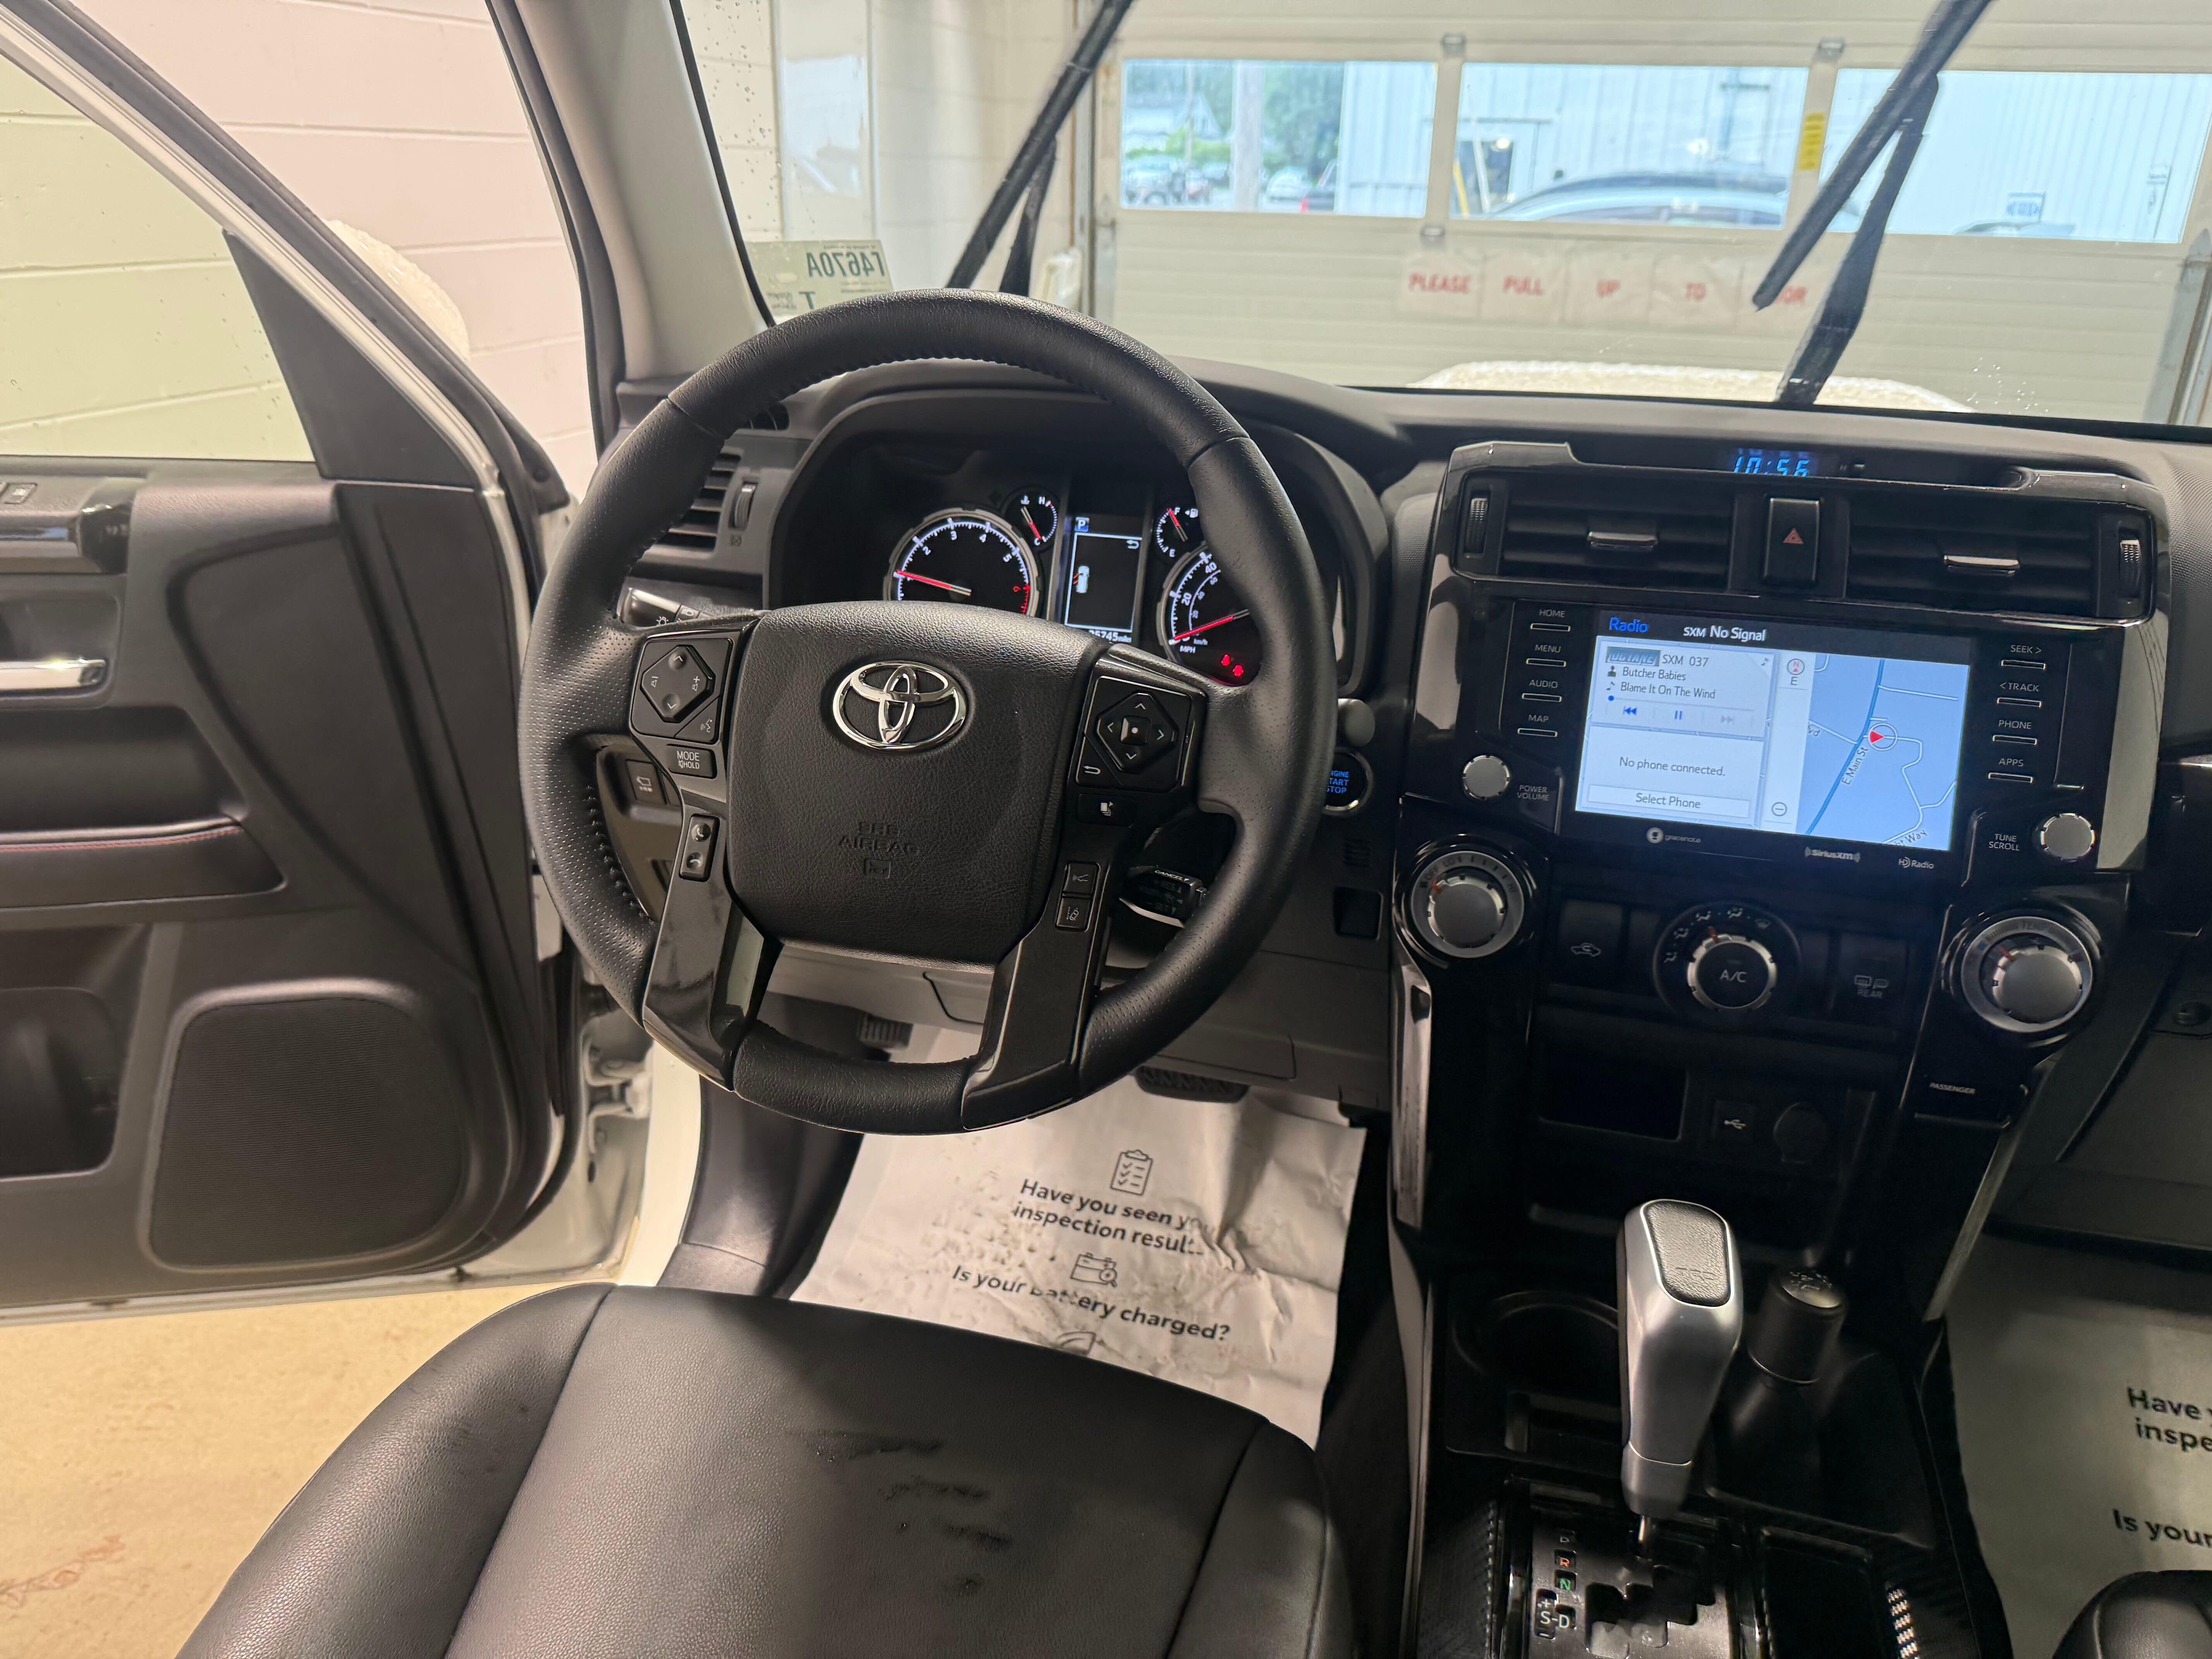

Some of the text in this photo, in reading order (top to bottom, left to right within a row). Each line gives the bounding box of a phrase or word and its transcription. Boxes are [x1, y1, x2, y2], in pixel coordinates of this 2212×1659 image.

[1408, 274, 1469, 294] PLEASE
[1503, 276, 1544, 295] PULL
[1596, 280, 1620, 298] UP
[1685, 283, 1706, 302] TO
[1174, 507, 1180, 515] F
[1078, 519, 1086, 530] P
[950, 531, 957, 541] 3
[979, 534, 987, 543] 4
[922, 546, 931, 555] 2
[1169, 549, 1175, 557] E
[1003, 554, 1012, 562] 5
[1205, 562, 1217, 574] 40
[1181, 592, 1192, 606] 20
[1539, 609, 1565, 618] HOME
[1609, 617, 1649, 634] Radio
[1683, 625, 1767, 642] SXM No Signal
[1180, 645, 1196, 653] MPH
[1535, 644, 1561, 653] MENU
[1662, 654, 1683, 665] SXM
[1689, 656, 1709, 667] 037
[1622, 666, 1686, 681] Butcher Babies
[1529, 679, 1558, 689] AUDIO
[1790, 677, 1797, 686] E
[1621, 682, 1716, 699] Blame It On The Wind
[2008, 682, 2039, 692] TRACK
[1528, 714, 1549, 723] MAP
[1998, 720, 2032, 730] PHONE
[677, 750, 699, 761] MODE
[683, 760, 700, 769] HOLD
[1619, 757, 1726, 776] No phone connected.
[1845, 758, 1863, 778] Main
[1856, 747, 1869, 757] St
[1998, 758, 2024, 768] APPS
[1331, 770, 1349, 778] GINE
[1329, 778, 1349, 786] TART
[1519, 784, 1547, 793] POWER
[1517, 792, 1549, 801] VOLUME
[1635, 793, 1701, 809] Select Phone
[1665, 833, 1701, 843] gracenote
[1905, 830, 1927, 843] Way
[1994, 833, 2016, 842] TUNE
[1989, 841, 2020, 852] SCROLL
[1911, 860, 1934, 869] Radio
[1425, 866, 1439, 880] OFF
[1720, 969, 1747, 984] A/C
[1857, 989, 1883, 999] REAR
[1929, 1082, 1976, 1095] PASSENGER
[1020, 1178, 1073, 1205] Have
[1076, 1193, 1116, 1216] you
[1122, 1206, 1172, 1226] seen
[1013, 1201, 1203, 1255] inspection resul
[952, 1265, 971, 1281] Is
[973, 1273, 1027, 1293] your
[1120, 1306, 1230, 1341] charged?
[2127, 1387, 2202, 1420] Have
[2113, 1509, 2138, 1532] Is
[1560, 1557, 1570, 1567] R
[1560, 1578, 1571, 1590] N
